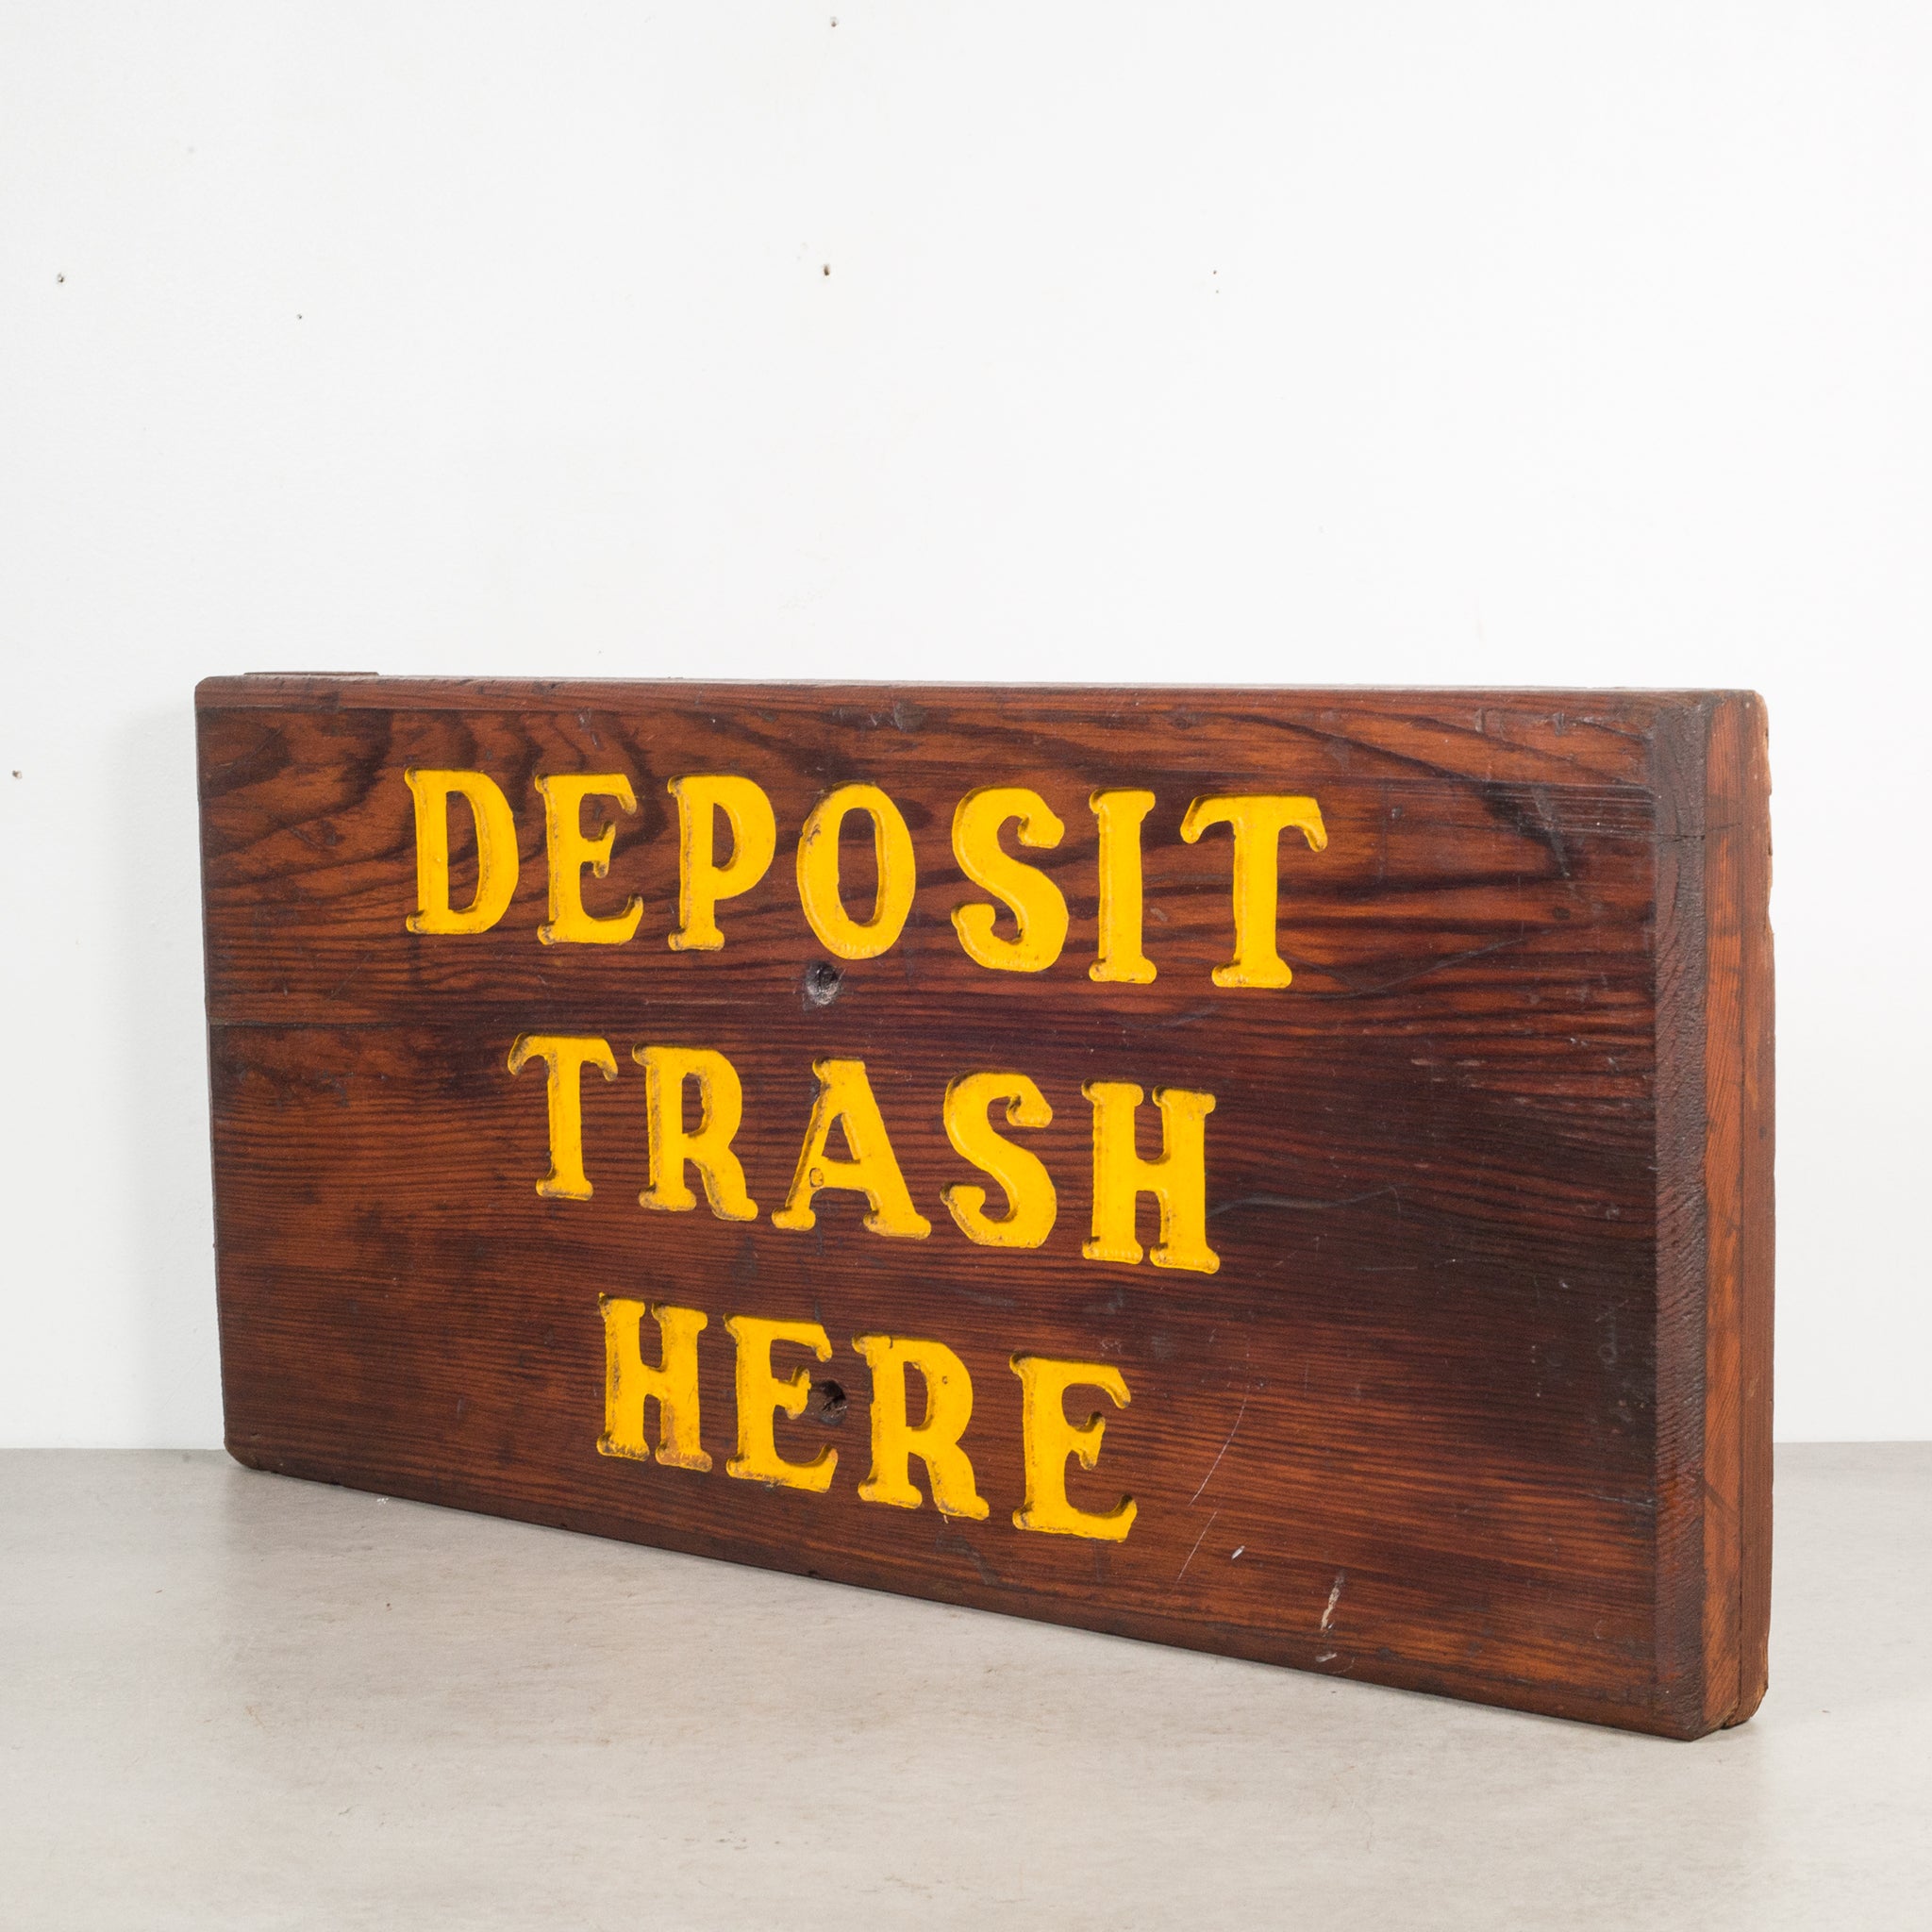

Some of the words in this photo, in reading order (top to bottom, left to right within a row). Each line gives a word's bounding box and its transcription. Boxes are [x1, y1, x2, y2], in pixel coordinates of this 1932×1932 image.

[404, 766, 1329, 991] DEPOSIT
[507, 1033, 1221, 1275] TRASH
[595, 1291, 1138, 1543] HERE
